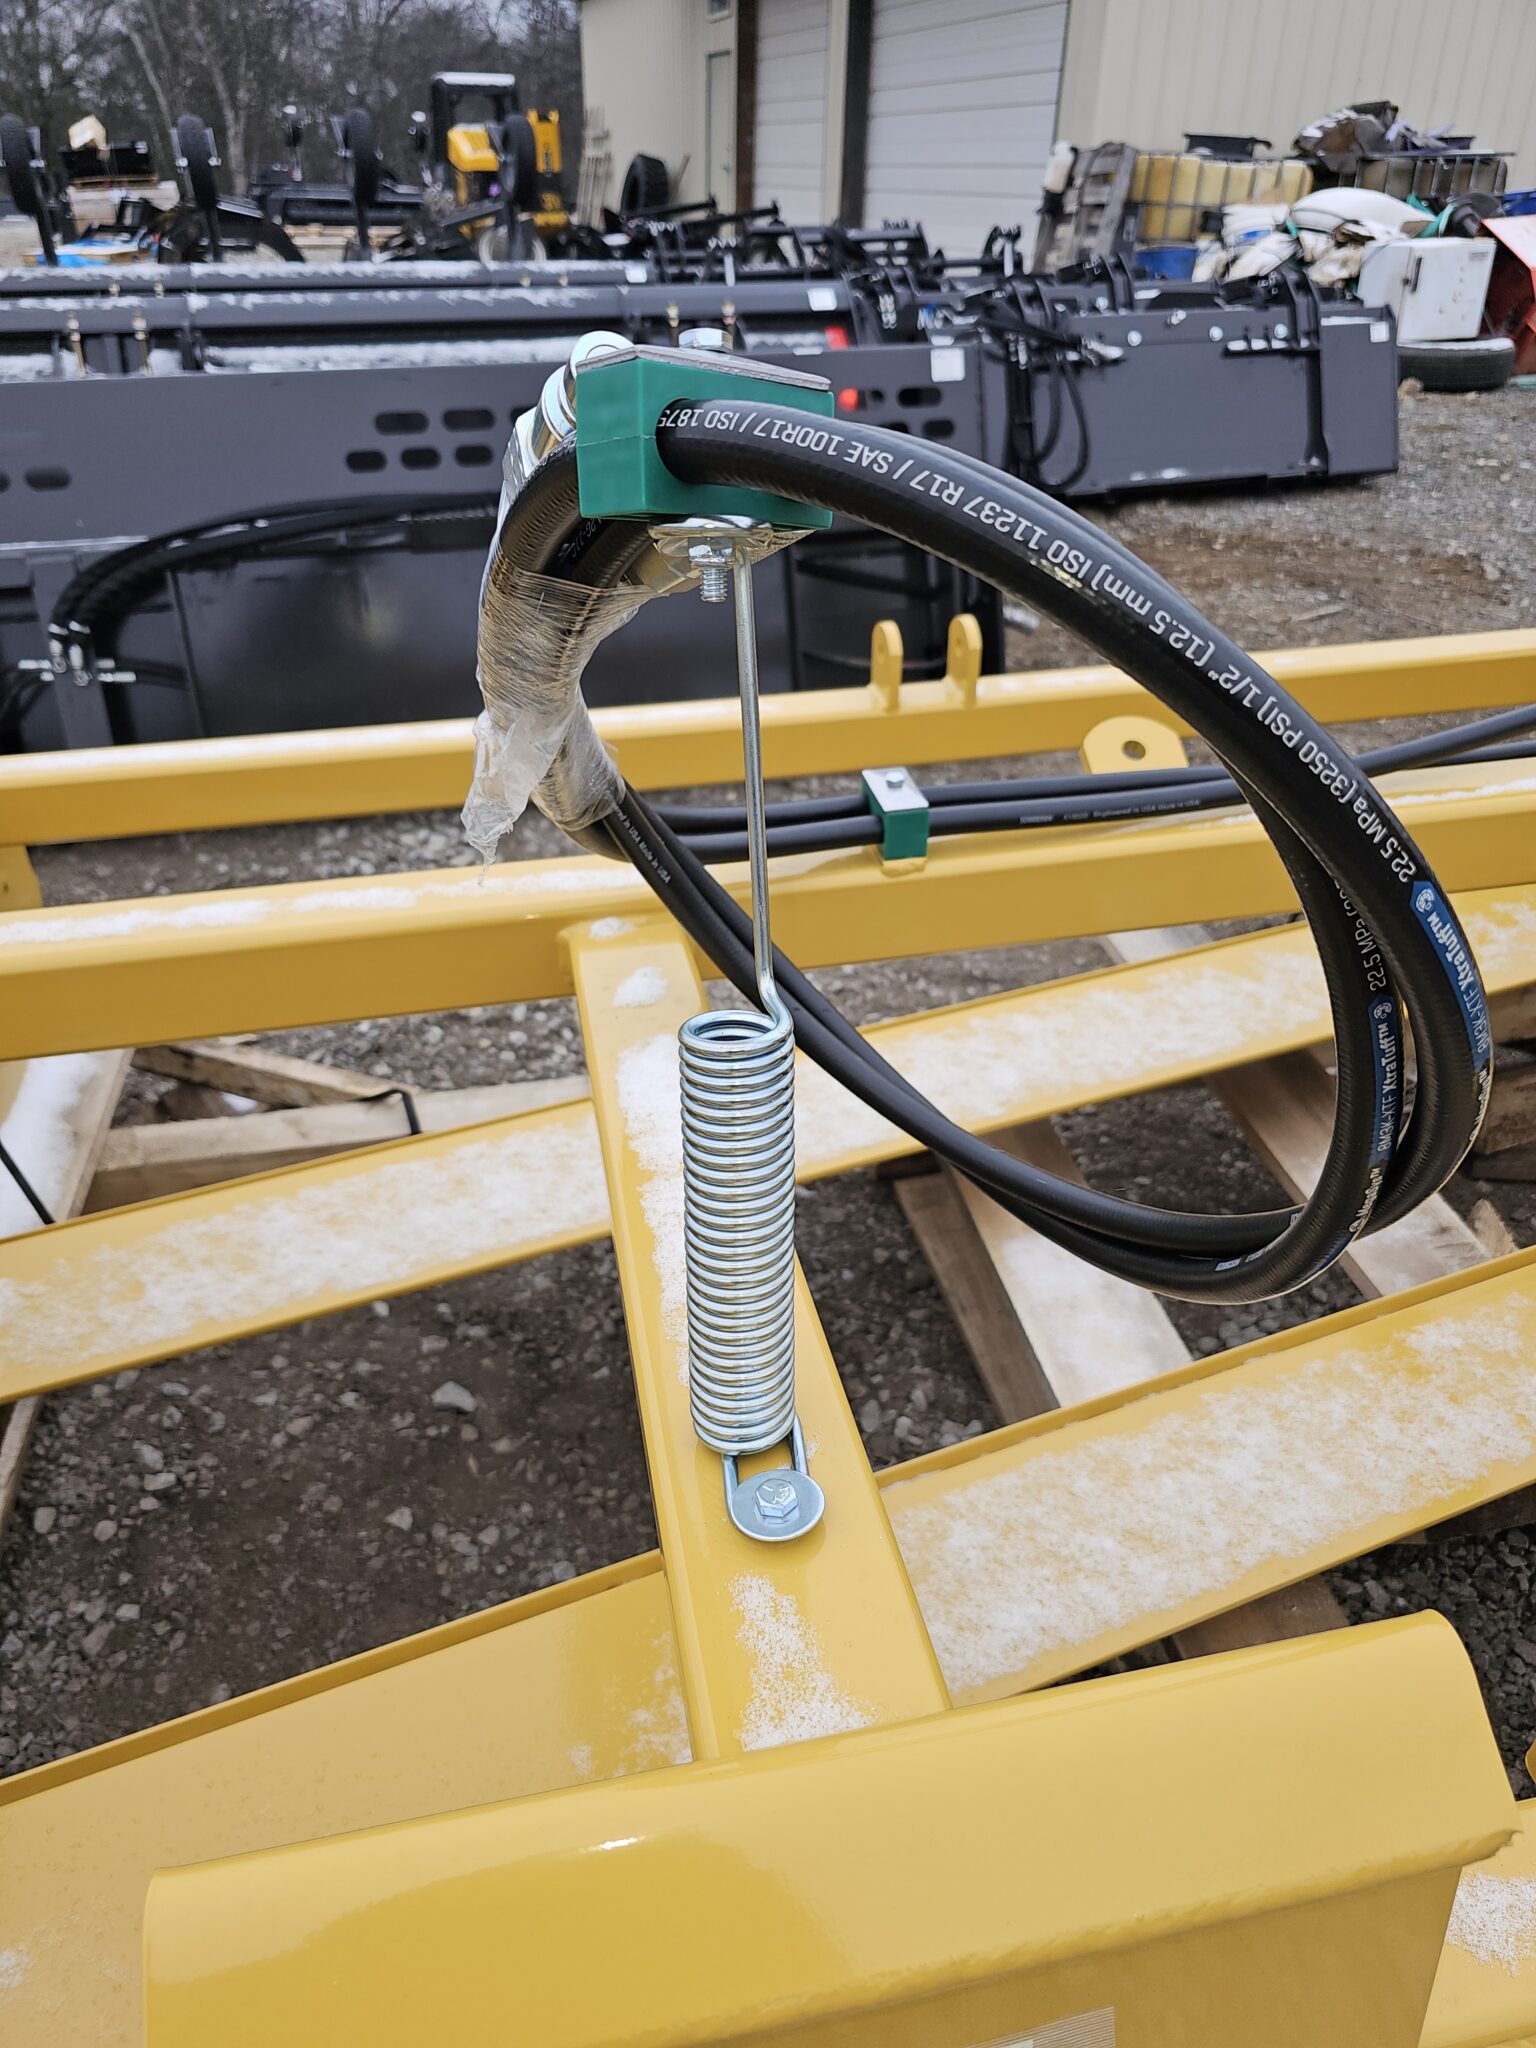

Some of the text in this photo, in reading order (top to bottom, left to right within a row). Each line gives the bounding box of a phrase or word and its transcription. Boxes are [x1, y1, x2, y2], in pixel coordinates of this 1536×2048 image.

[704, 409, 738, 432] ISO
[738, 411, 758, 433] /
[753, 416, 845, 457] 100R17
[843, 440, 894, 475] SAE
[892, 458, 915, 481] /
[909, 469, 965, 506] R17
[962, 495, 1049, 551] 11237
[1046, 538, 1094, 580] ISO
[1353, 793, 1390, 844] MPa
[1380, 837, 1417, 883] 22.5
[1363, 953, 1387, 991] 22.5
[1377, 1094, 1398, 1152] 8M3K-XTF
